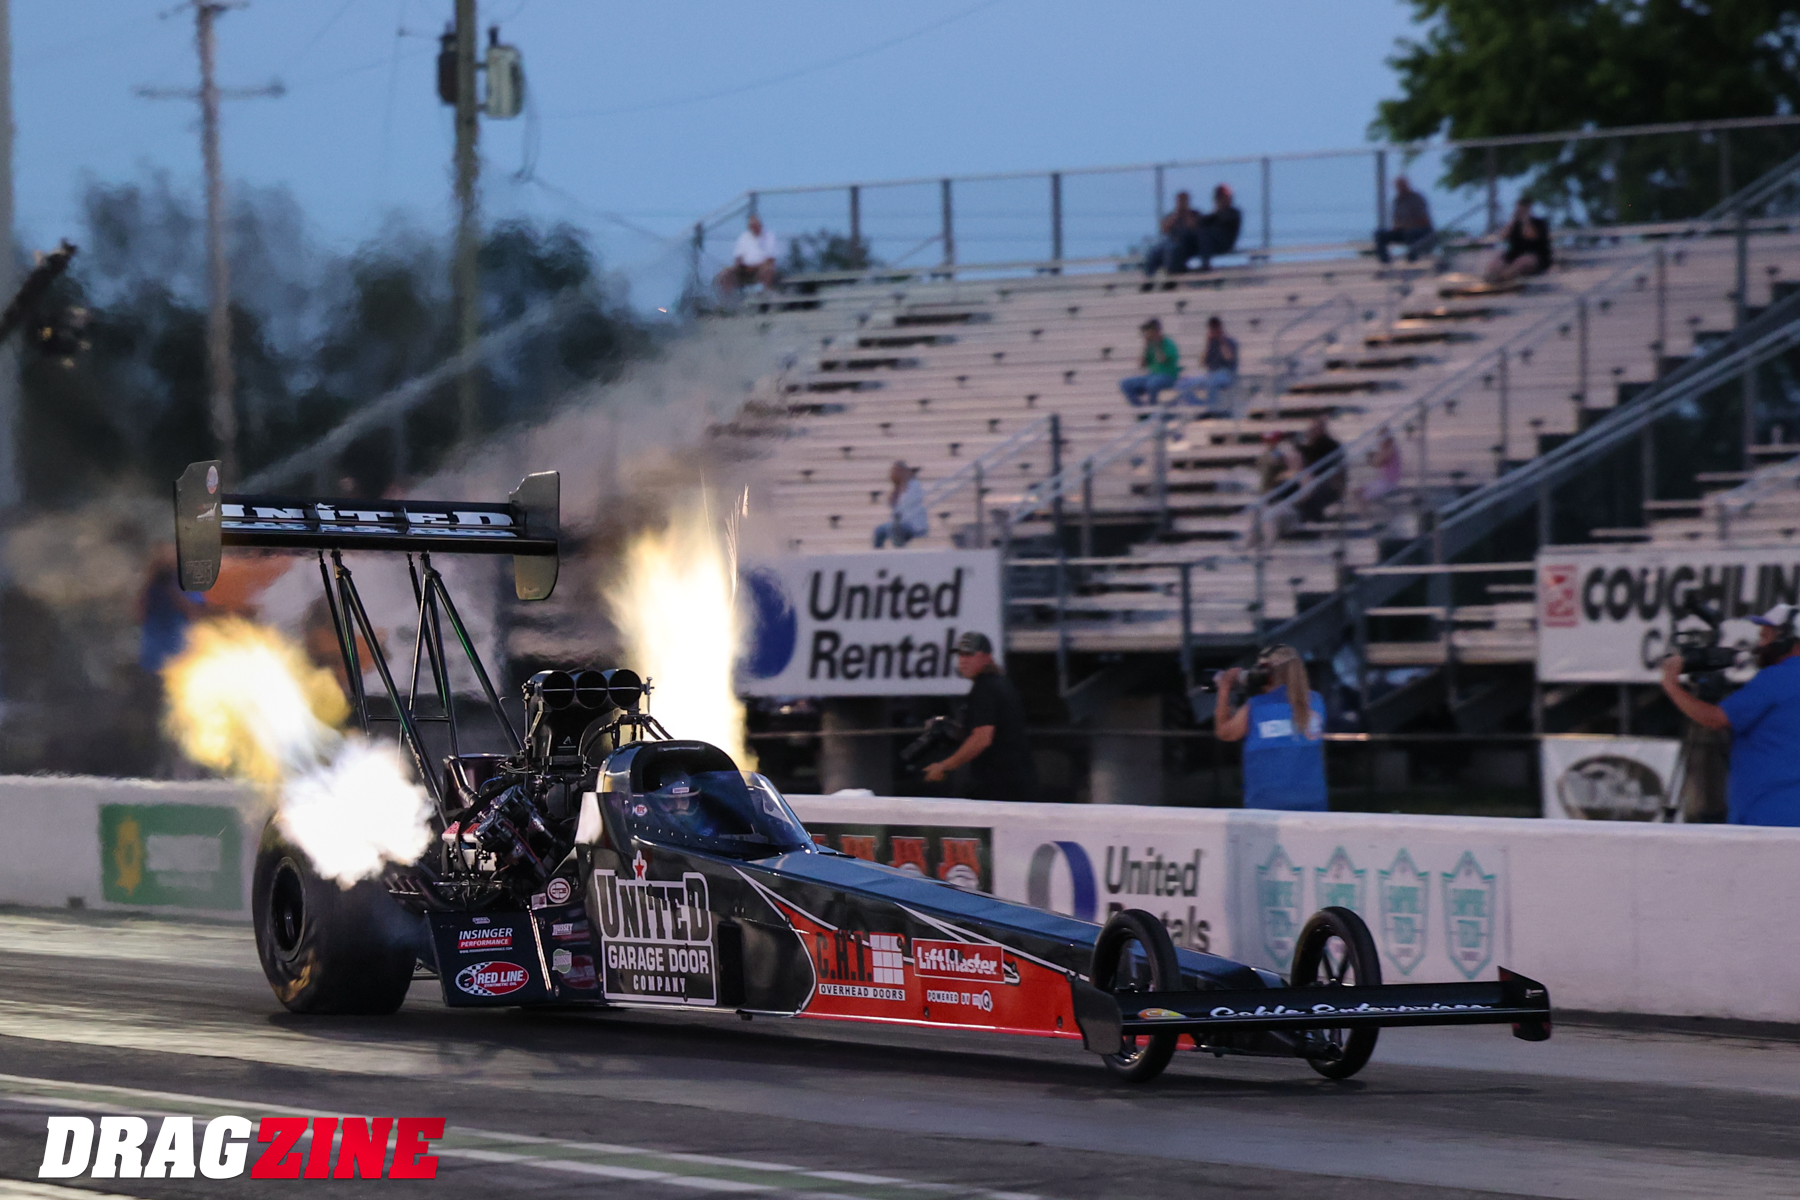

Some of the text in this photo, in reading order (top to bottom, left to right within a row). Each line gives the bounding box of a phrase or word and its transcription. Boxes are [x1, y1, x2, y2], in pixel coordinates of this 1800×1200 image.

[809, 567, 964, 621] United
[808, 629, 964, 680] Rental
[1106, 846, 1203, 897] United
[594, 868, 712, 942] UNITED
[459, 927, 513, 940] INSINGER
[460, 938, 509, 948] PERFORMANCE
[607, 945, 710, 974] GARAGE DOOR
[917, 946, 998, 975] LiftMaster
[477, 970, 524, 985] RED LINE
[633, 975, 686, 993] COMPANY
[820, 985, 904, 1000] OVERHEAD DOORS
[927, 990, 958, 1003] POWERED
